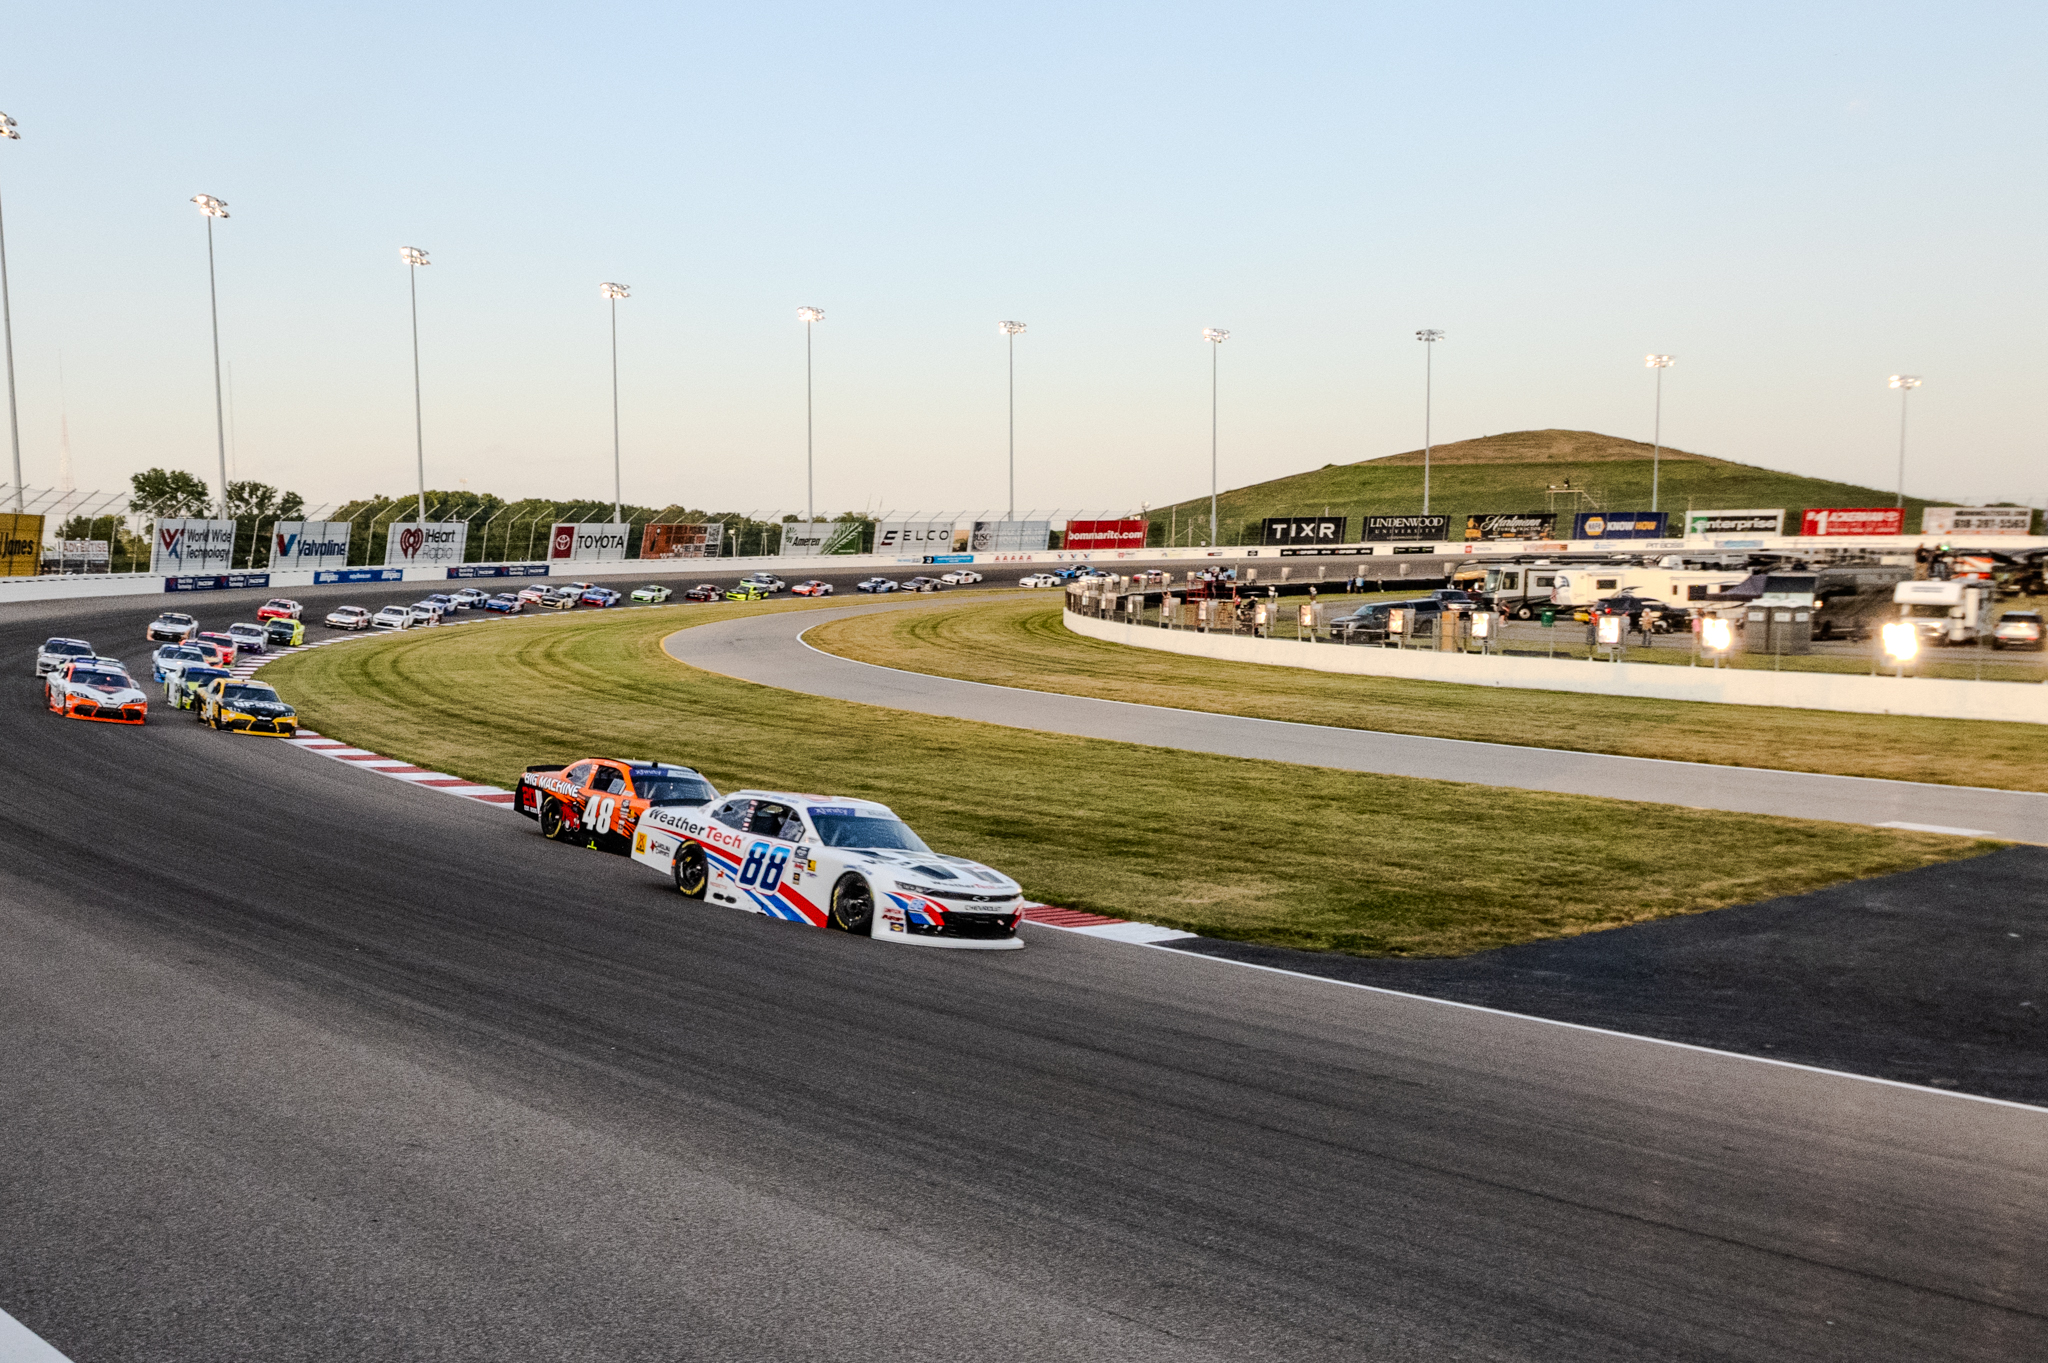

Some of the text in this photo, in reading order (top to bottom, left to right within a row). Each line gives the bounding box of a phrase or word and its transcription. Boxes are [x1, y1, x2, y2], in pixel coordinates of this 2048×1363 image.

[1370, 517, 1444, 527] LINDENWOOD
[1480, 515, 1541, 531] Hartmann
[1606, 521, 1657, 531] KNOW HOW
[1692, 518, 1776, 530] enterprise
[187, 528, 232, 543] World Wide
[424, 528, 456, 544] iHeart
[902, 530, 949, 541] ELCO
[1068, 530, 1143, 541] bommarito.com
[1272, 523, 1335, 539] TIXR
[297, 540, 346, 557] Valvoline
[578, 535, 624, 549] TOYOTA
[791, 536, 821, 547] Ameren
[186, 545, 231, 561] Technology
[524, 772, 581, 798] BIG MACHINE
[582, 794, 615, 835] 48
[649, 808, 742, 849] WeatherTech
[739, 841, 791, 891] 88
